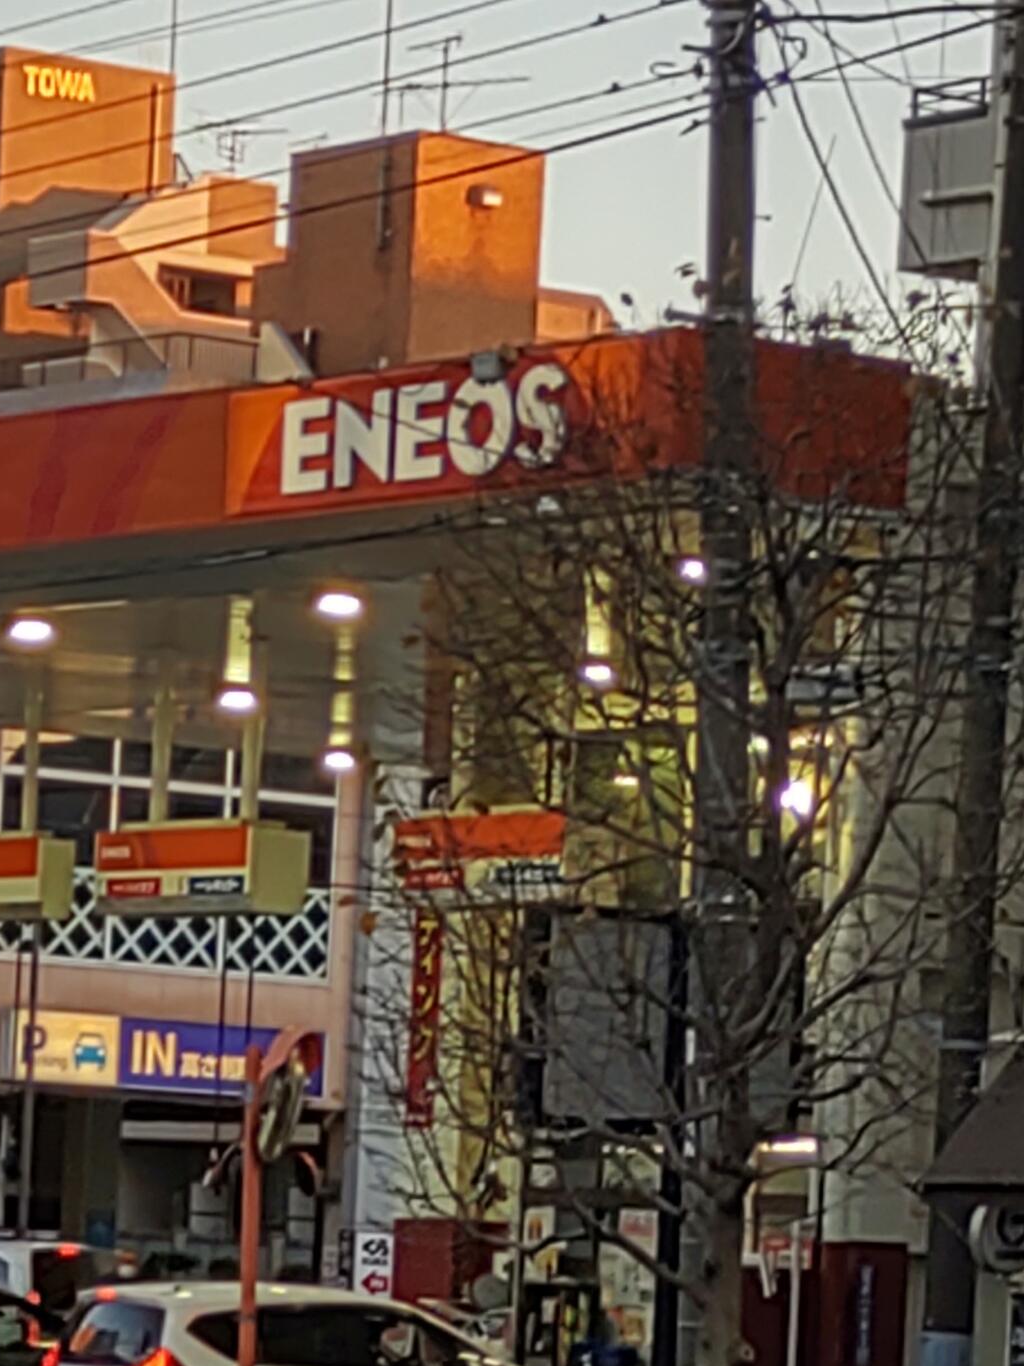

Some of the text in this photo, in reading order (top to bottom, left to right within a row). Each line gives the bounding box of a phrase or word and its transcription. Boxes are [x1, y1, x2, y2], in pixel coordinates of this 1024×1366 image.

[23, 65, 95, 102] TOWA
[280, 362, 568, 496] ENEOS
[131, 1030, 177, 1078] IN
